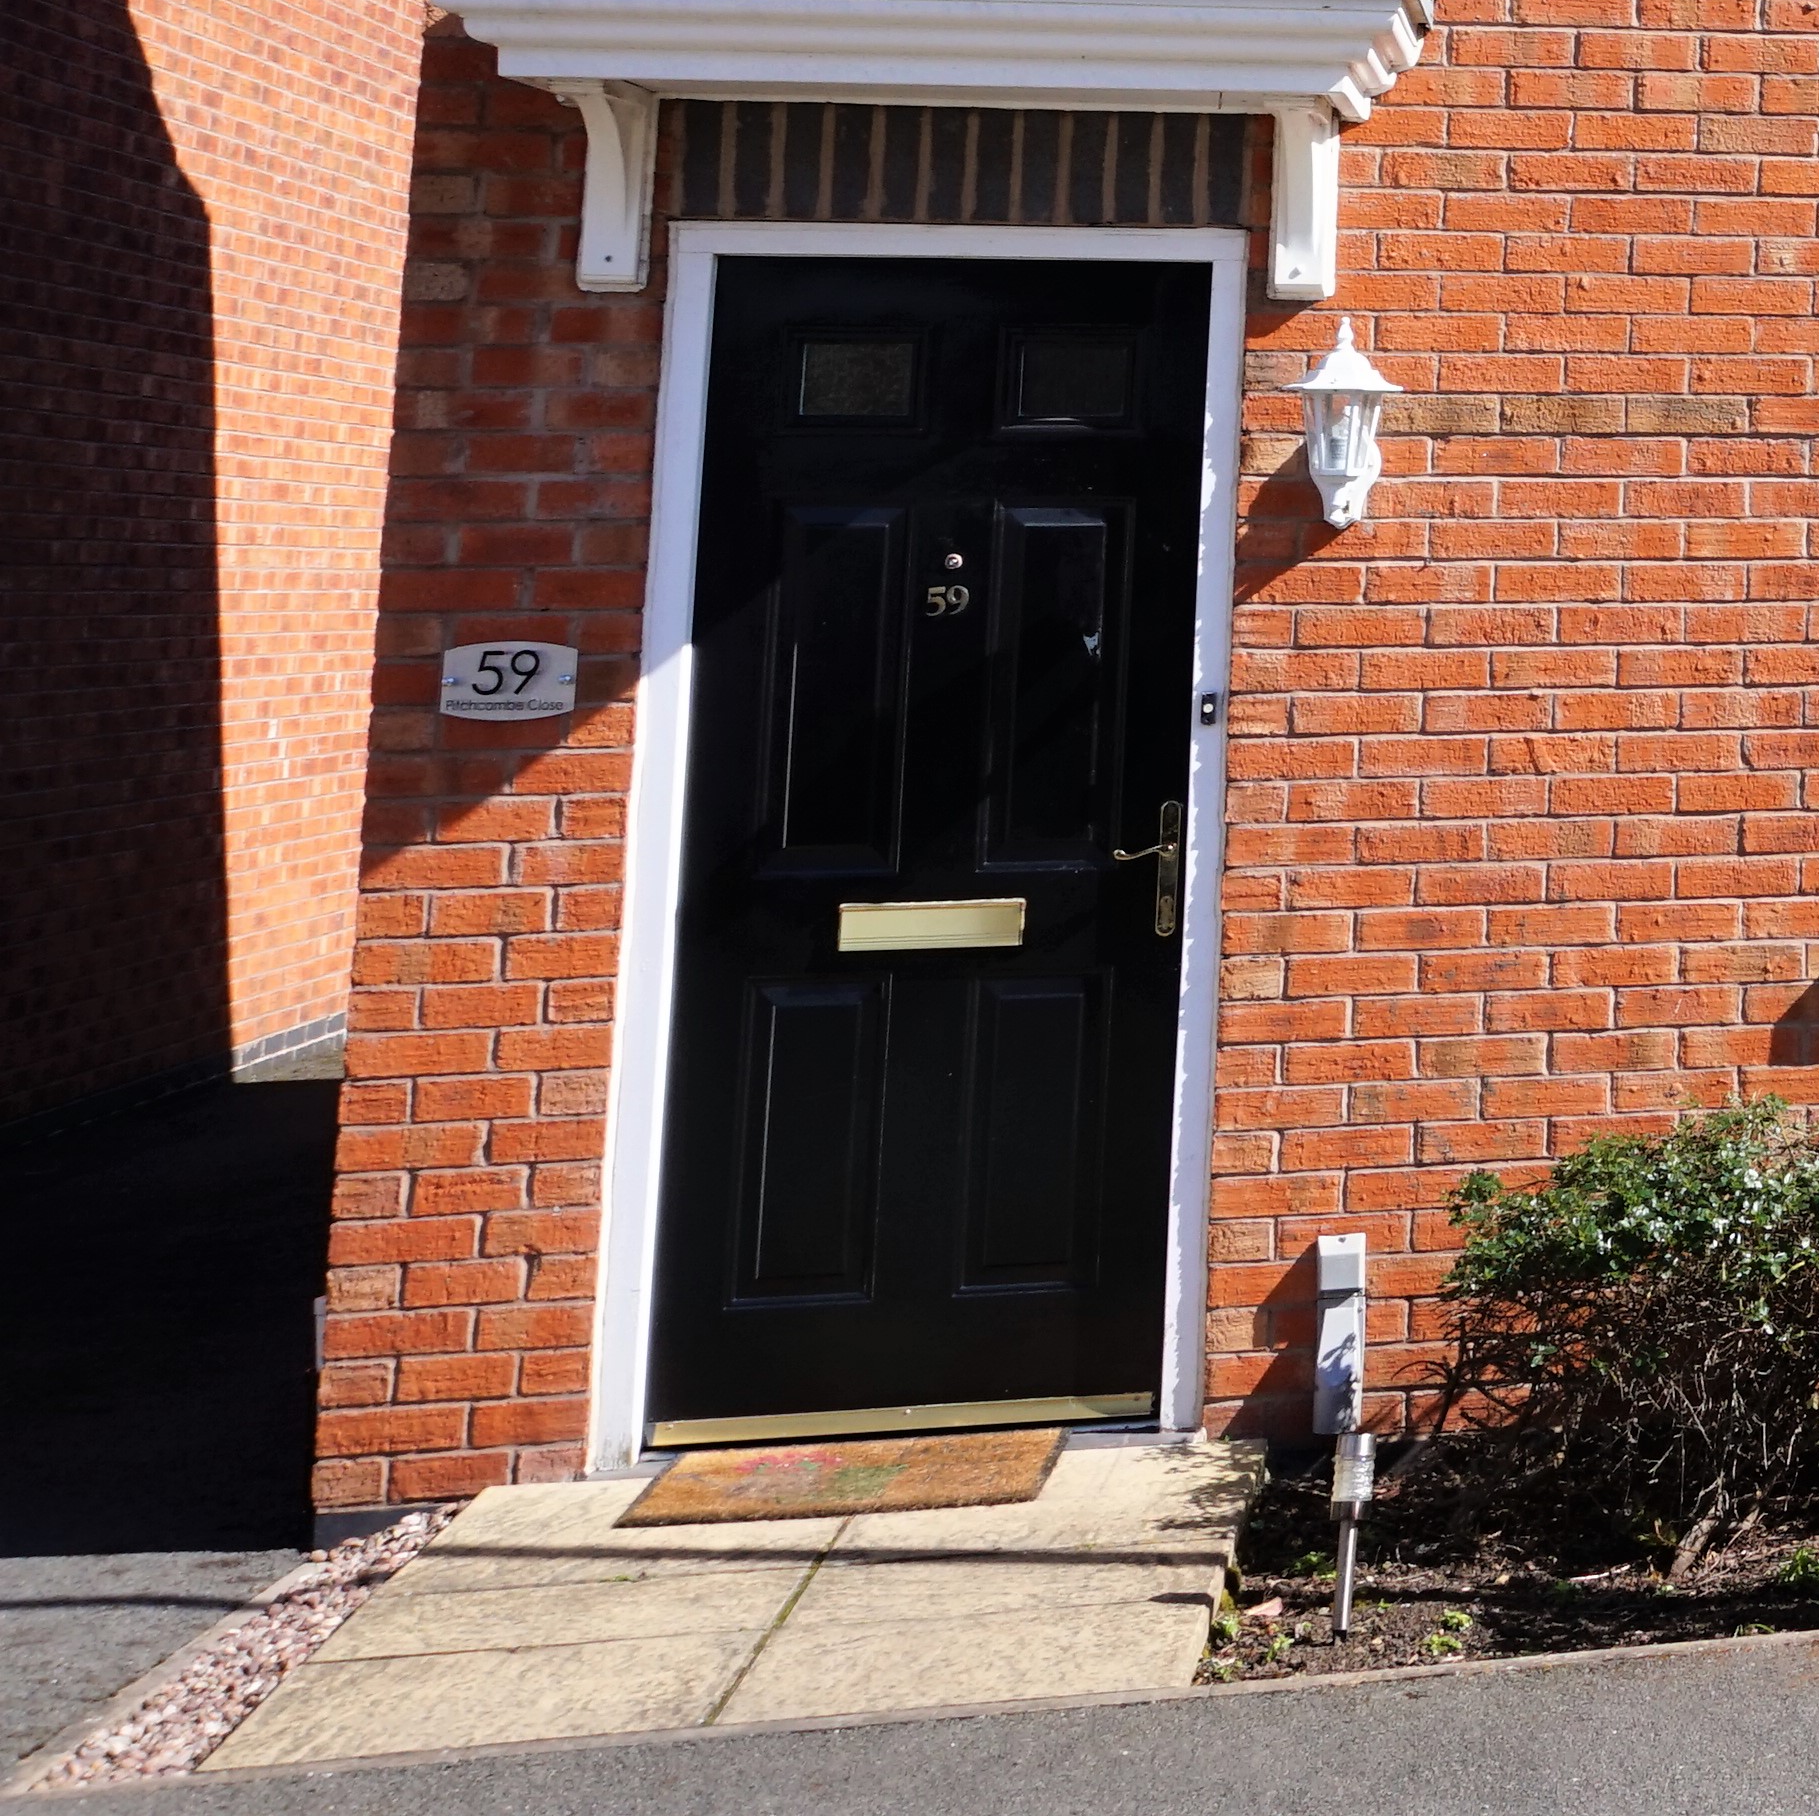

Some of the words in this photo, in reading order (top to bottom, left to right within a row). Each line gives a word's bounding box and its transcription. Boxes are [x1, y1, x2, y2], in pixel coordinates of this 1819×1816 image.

[925, 584, 970, 617] 59
[471, 649, 541, 696] 59
[445, 699, 524, 711] Pitchcombe
[527, 698, 564, 711] Close
